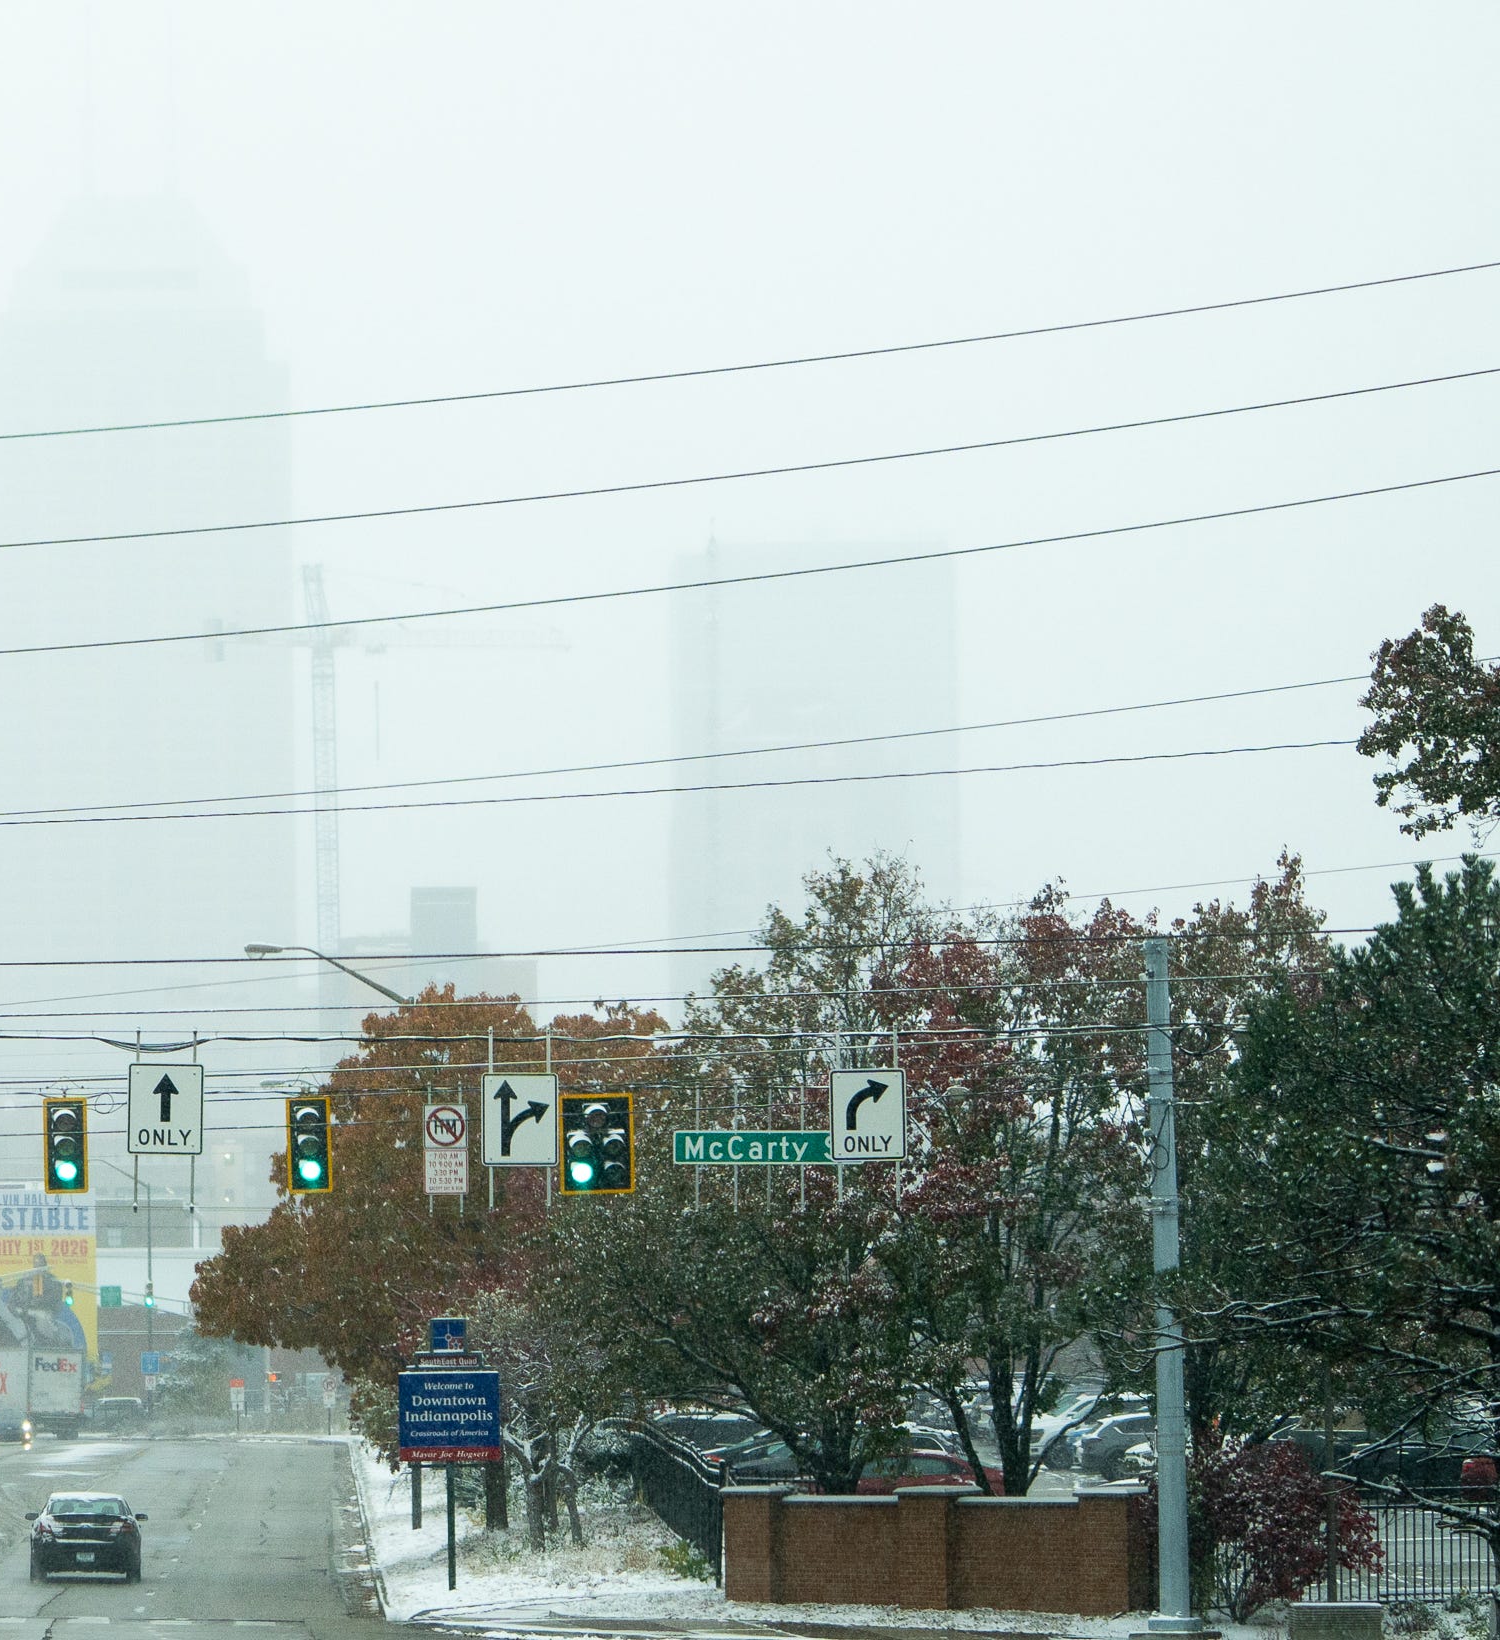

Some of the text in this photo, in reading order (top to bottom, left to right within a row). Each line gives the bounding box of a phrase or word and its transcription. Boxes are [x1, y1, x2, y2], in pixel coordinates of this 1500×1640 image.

[138, 1129, 192, 1146] ONLY
[844, 1135, 892, 1152] ONLY
[684, 1136, 808, 1161] McCarty
[24, 1193, 50, 1206] HALL
[27, 1239, 45, 1256] 1ST
[51, 1239, 88, 1256] 2026
[35, 1357, 77, 1372] FedEx
[458, 1356, 478, 1365] Quad
[424, 1382, 474, 1390] Welcome to
[412, 1395, 486, 1407] Downtown
[405, 1410, 493, 1424] Indianapolis
[410, 1429, 449, 1437] Crossroads
[450, 1429, 459, 1437] of
[411, 1450, 488, 1459] Mayor Joe Hogsett
